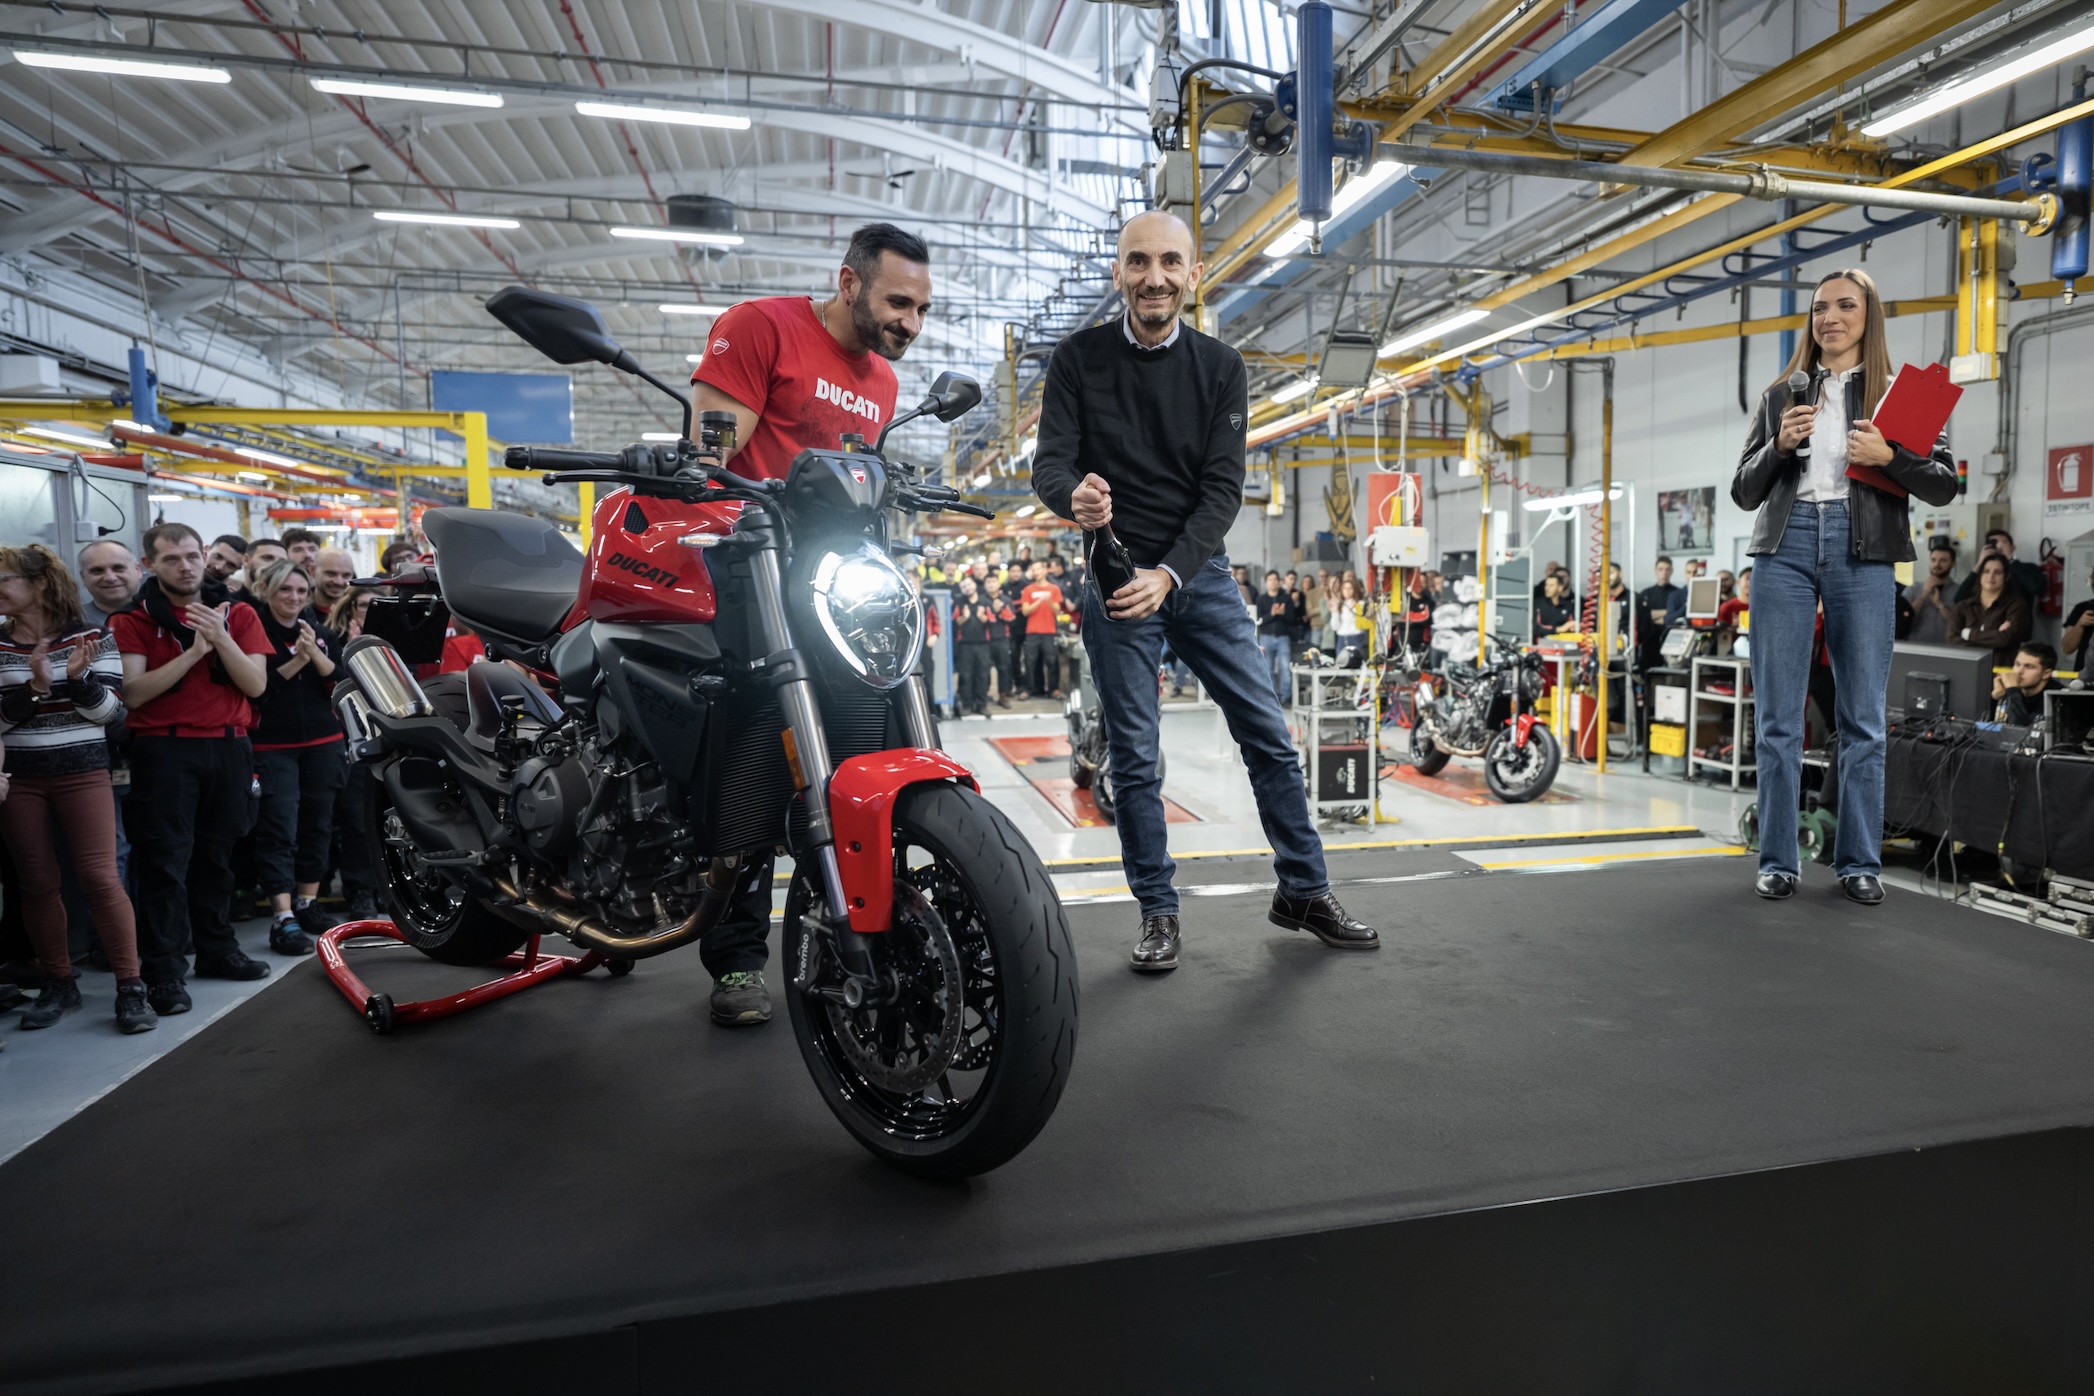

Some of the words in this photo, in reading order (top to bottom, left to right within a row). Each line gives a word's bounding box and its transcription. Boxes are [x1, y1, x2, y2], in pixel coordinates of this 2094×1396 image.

[815, 377, 880, 424] DUCATI
[606, 551, 680, 588] DUCATI
[1346, 757, 1356, 794] DUCATI
[799, 933, 809, 981] brembo
